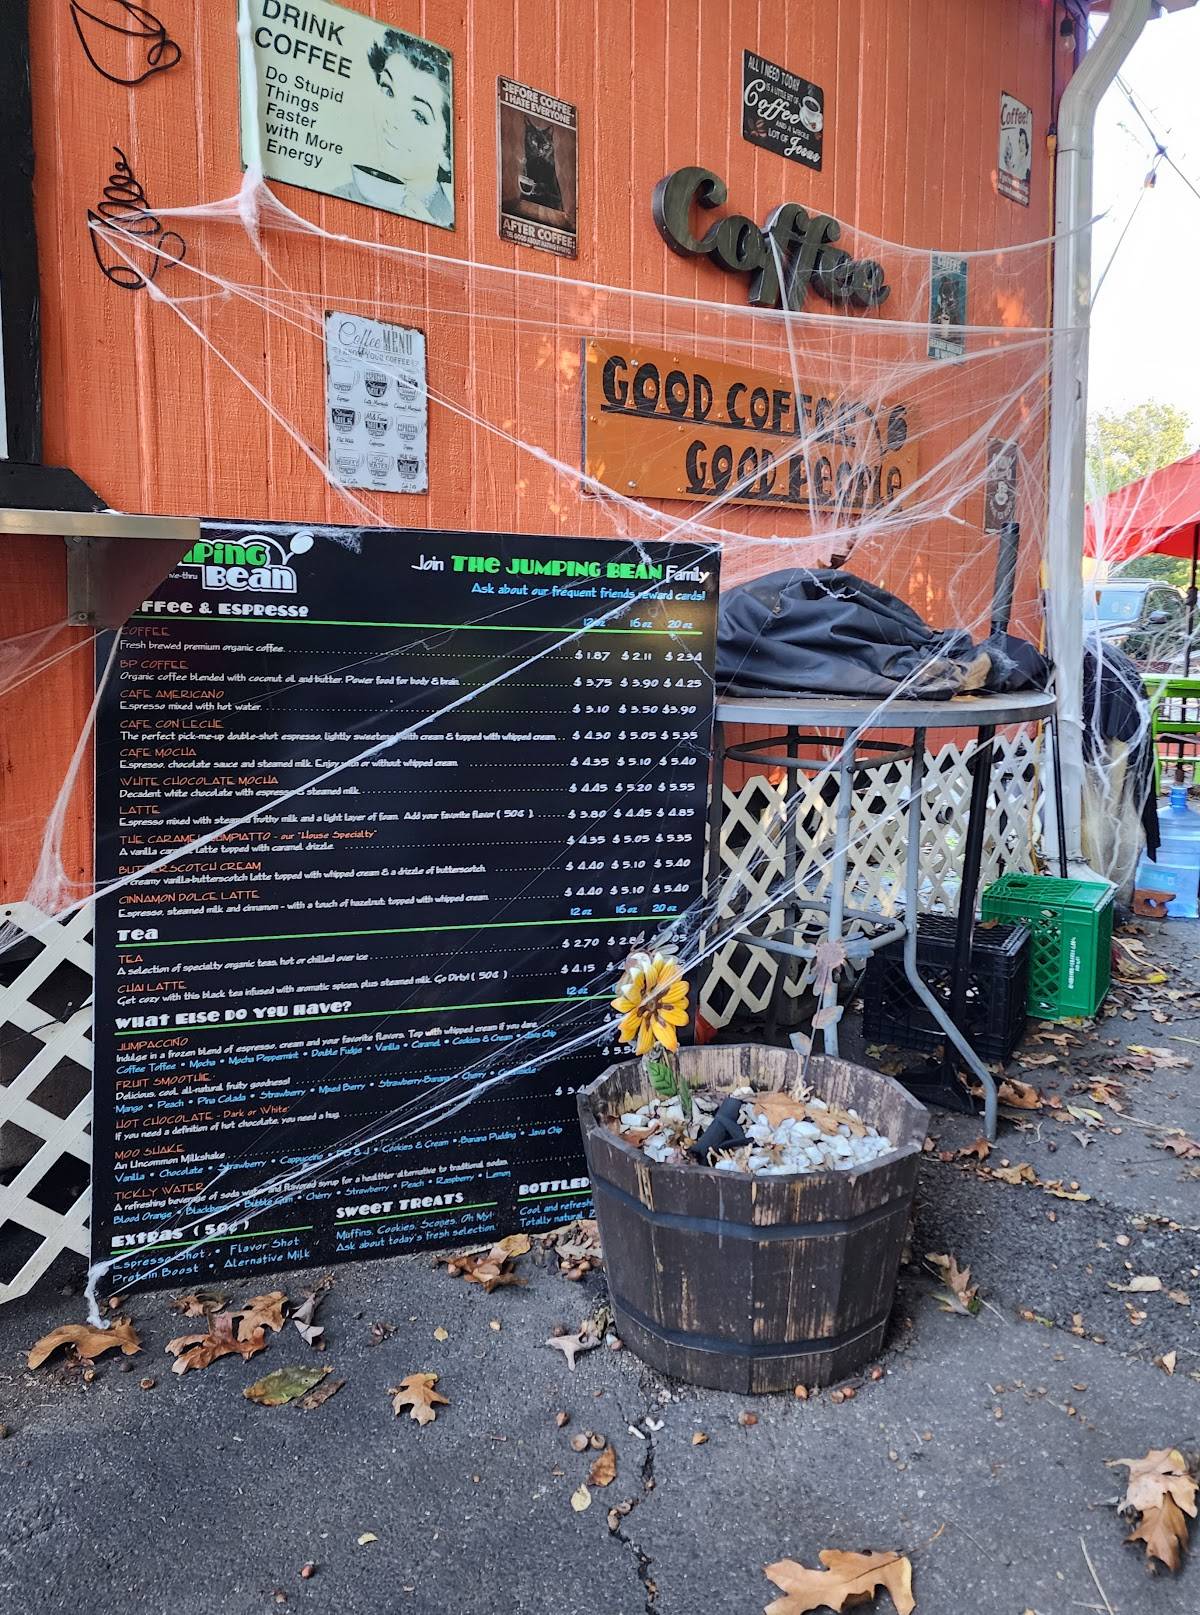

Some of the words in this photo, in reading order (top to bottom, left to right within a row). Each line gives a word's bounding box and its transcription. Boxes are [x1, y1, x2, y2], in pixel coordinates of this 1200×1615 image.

[261, 0, 345, 46] DRINK
[254, 27, 353, 79] COFFEE
[748, 56, 759, 72] ALL
[761, 61, 764, 74] I
[765, 64, 780, 81] NEED
[782, 72, 800, 91] TODAY
[265, 66, 288, 83] Do
[295, 75, 344, 103] Stupid
[502, 81, 538, 103] BEFORE
[266, 84, 319, 113] Things
[745, 79, 800, 124] Coffee
[774, 87, 786, 100] LITTLE
[266, 103, 317, 129] Faster
[505, 92, 508, 101] I
[510, 94, 530, 109] HATE
[531, 103, 570, 124] EVERYONE
[768, 128, 780, 140] LOT
[776, 121, 787, 130] AND
[792, 129, 809, 140] WHOLE
[780, 133, 789, 143] OF
[266, 123, 299, 145] with
[305, 134, 343, 155] More
[267, 139, 323, 169] Energy
[784, 137, 820, 162] Jesus
[503, 219, 535, 237] AFTER
[652, 165, 891, 311] Coffee
[383, 329, 412, 355] MENU
[601, 355, 713, 421] GOOD
[685, 439, 776, 499] GOOD
[411, 554, 444, 571] Join
[505, 558, 602, 578] JUMPING
[606, 562, 663, 580] BEAN
[665, 565, 710, 583] Family
[205, 566, 293, 589] Bean
[471, 583, 494, 594] Ask
[498, 584, 529, 596] about
[531, 586, 548, 596] our
[552, 586, 596, 599] frequent
[600, 587, 635, 599] friends
[637, 588, 673, 600] reward
[675, 590, 706, 601] cards!
[199, 602, 212, 614] &
[121, 627, 170, 637] COFFEE
[630, 619, 640, 628] 16
[667, 620, 682, 629] 20
[120, 640, 146, 650] Fresh
[149, 641, 181, 650] brewed
[184, 643, 220, 651] premium
[222, 644, 253, 652] organic
[120, 660, 138, 669] BP
[141, 660, 190, 670] COFFEE
[120, 672, 154, 681] Organic
[158, 673, 187, 681] coffee
[190, 673, 225, 682] blended
[227, 674, 246, 682] with
[248, 675, 283, 683] coconut
[120, 690, 153, 699] CAFE
[155, 689, 225, 699] AMERICANO
[120, 701, 166, 711] Espresso
[168, 702, 193, 710] mixed
[195, 702, 215, 710] with
[217, 702, 232, 711] hot
[120, 720, 152, 730] CAFE
[155, 719, 179, 729] CON
[182, 719, 225, 729] LECHE
[120, 731, 139, 740] The
[142, 732, 176, 741] perfect
[178, 732, 225, 742] pick-me-up
[227, 732, 278, 740] double-shot
[120, 748, 152, 758] CAFE
[155, 747, 197, 758] MOCHA
[168, 760, 211, 768] chocolate
[120, 777, 160, 786] WHITE
[162, 776, 235, 786] CHOCOLATE
[238, 775, 279, 786] MOCHA
[119, 789, 161, 798] Decadent
[164, 789, 188, 798] white
[190, 789, 233, 797] chocolate
[119, 805, 160, 815] LATTE
[118, 892, 176, 904] CINNAMON
[179, 892, 218, 902] DOLCE
[221, 890, 260, 900] LATTE
[118, 954, 144, 964] TEA
[118, 984, 144, 993] CHAI
[146, 980, 188, 991] LATTE
[117, 1037, 189, 1052] JUMPACCINO
[116, 1079, 149, 1091] FRUIT
[153, 1072, 212, 1086] SMOOTHIE
[116, 1118, 139, 1130] HOT
[143, 1112, 214, 1127] CHOCOLATE
[114, 1150, 140, 1160] MOO
[144, 1144, 185, 1156] SHAKE
[115, 1173, 145, 1183] Vanilla
[159, 1167, 203, 1178] Chocolate
[114, 1187, 158, 1201] TICKLY
[161, 1183, 204, 1195] WATER
[519, 1177, 590, 1195] BOTTLED
[520, 1205, 541, 1215] Cool
[461, 1214, 474, 1223] Oh
[520, 1216, 552, 1227] Totally
[230, 1243, 269, 1256] Flavor
[271, 1237, 300, 1249] Shot
[336, 1241, 355, 1252] Ask
[359, 1239, 385, 1249] about
[389, 1234, 423, 1245] today's
[426, 1231, 449, 1240] fresh
[287, 1249, 310, 1260] Milk
[162, 1264, 199, 1277] Boost
